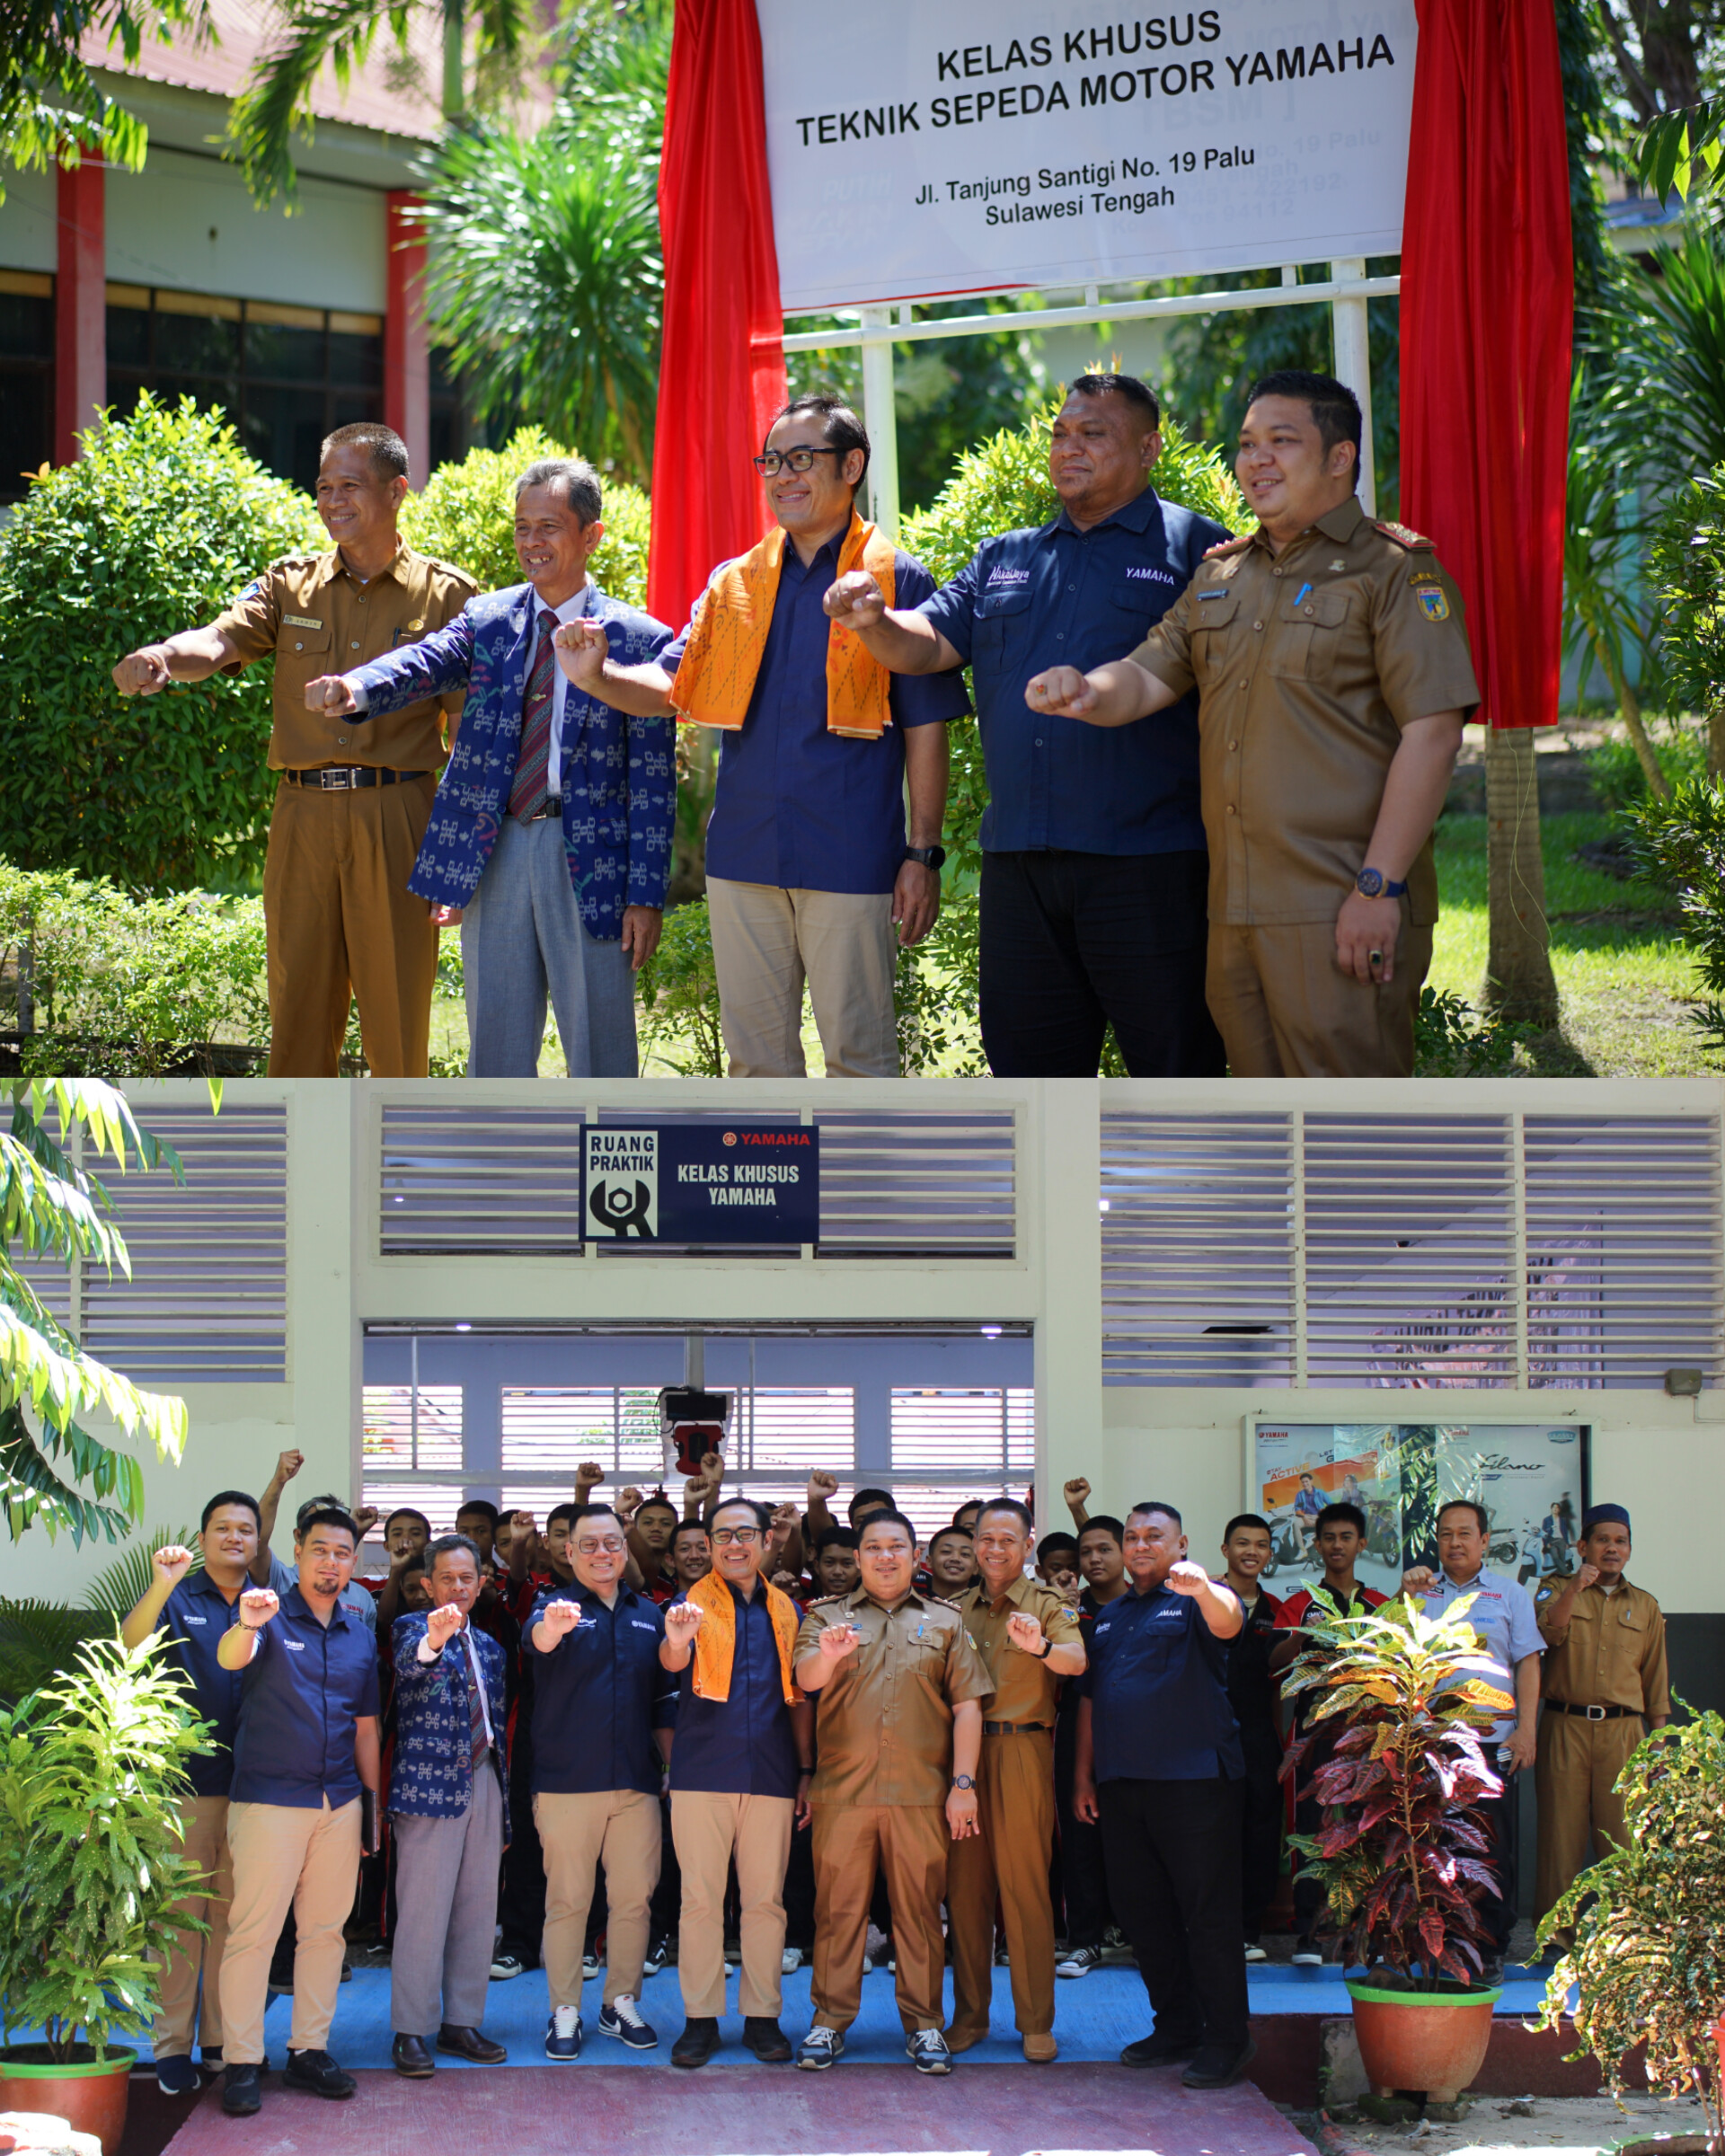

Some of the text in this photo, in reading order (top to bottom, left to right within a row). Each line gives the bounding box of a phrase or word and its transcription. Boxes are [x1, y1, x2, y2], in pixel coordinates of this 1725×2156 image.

[937, 35, 1053, 82] KELAS
[1064, 10, 1221, 63] KHUSUS
[795, 102, 920, 146] TEKNIK
[931, 80, 1070, 128] SEPEDA
[1080, 59, 1215, 108] MOTOR
[1225, 33, 1395, 87] YAMAHA
[916, 145, 1255, 206] Jl. Tanjung Santigi No. 19 Palu
[986, 185, 1175, 225] Sulawesi Tengah
[1126, 567, 1175, 586] YAMAHA
[590, 1135, 655, 1153] RUANG
[740, 1133, 810, 1145] YAMAHA
[589, 1154, 655, 1171] PRAKTIK
[677, 1164, 800, 1183] KELAS KHUSUS
[708, 1187, 777, 1206] YAMAHA
[1266, 1466, 1283, 1475] STAY
[1269, 1462, 1311, 1482] ACTIVE
